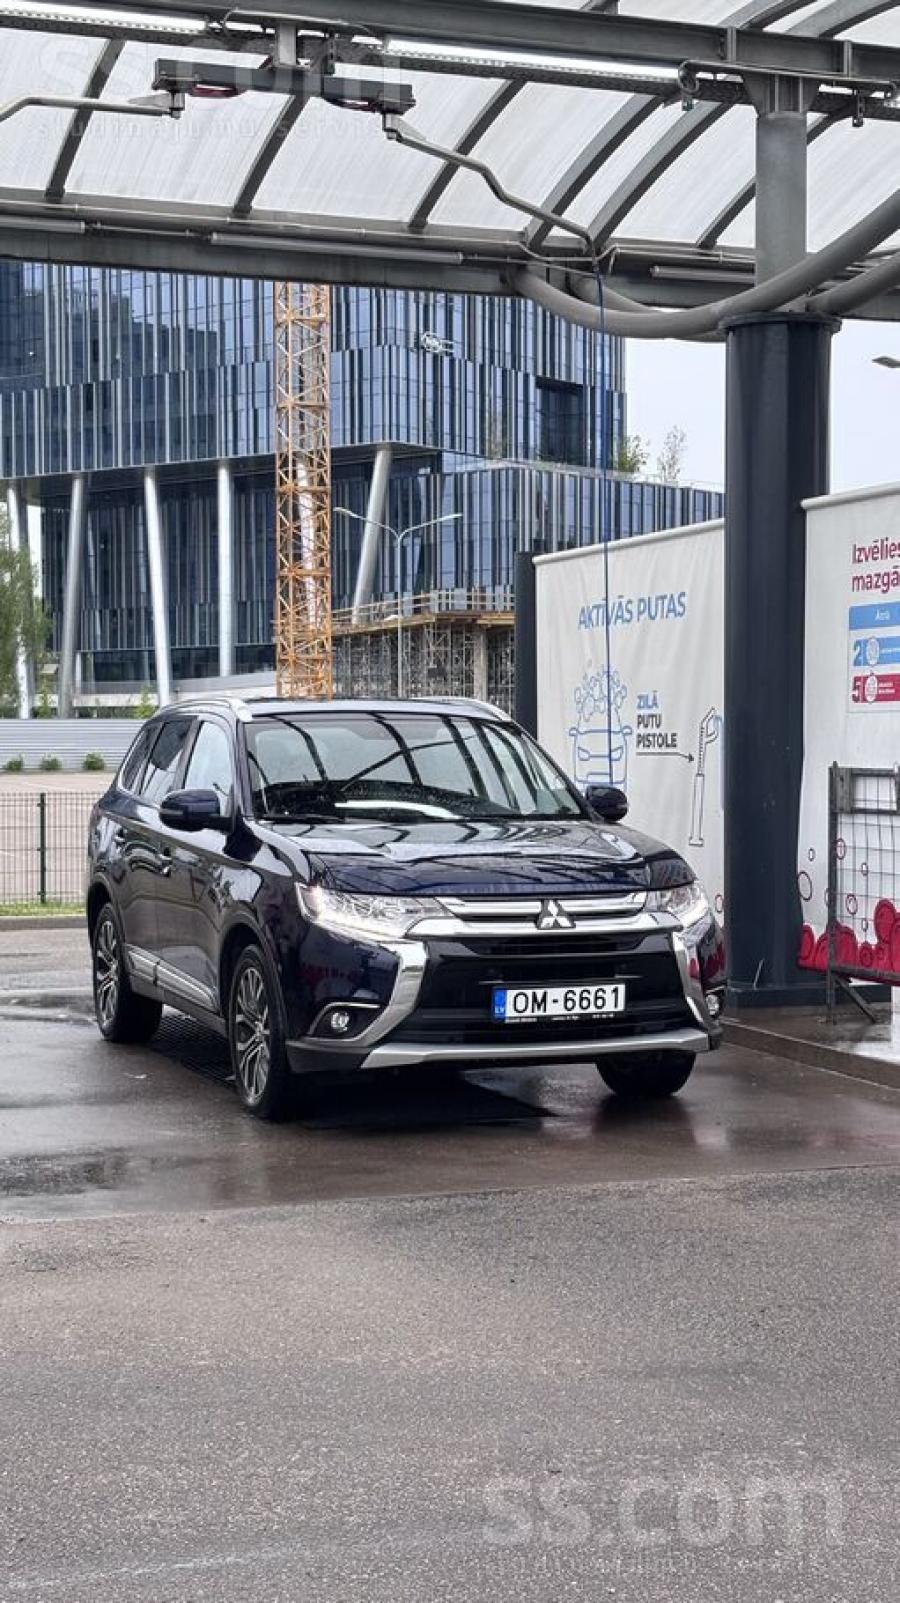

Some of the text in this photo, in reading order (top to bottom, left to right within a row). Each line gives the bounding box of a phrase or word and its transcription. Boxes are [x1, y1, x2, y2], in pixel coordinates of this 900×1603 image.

[578, 592, 686, 630] AKTĪVĀS PUTAS
[636, 690, 659, 710] ZILĀ
[636, 714, 662, 729] PUTU
[636, 732, 677, 748] PISTOLE
[513, 986, 619, 1014] OM-6661
